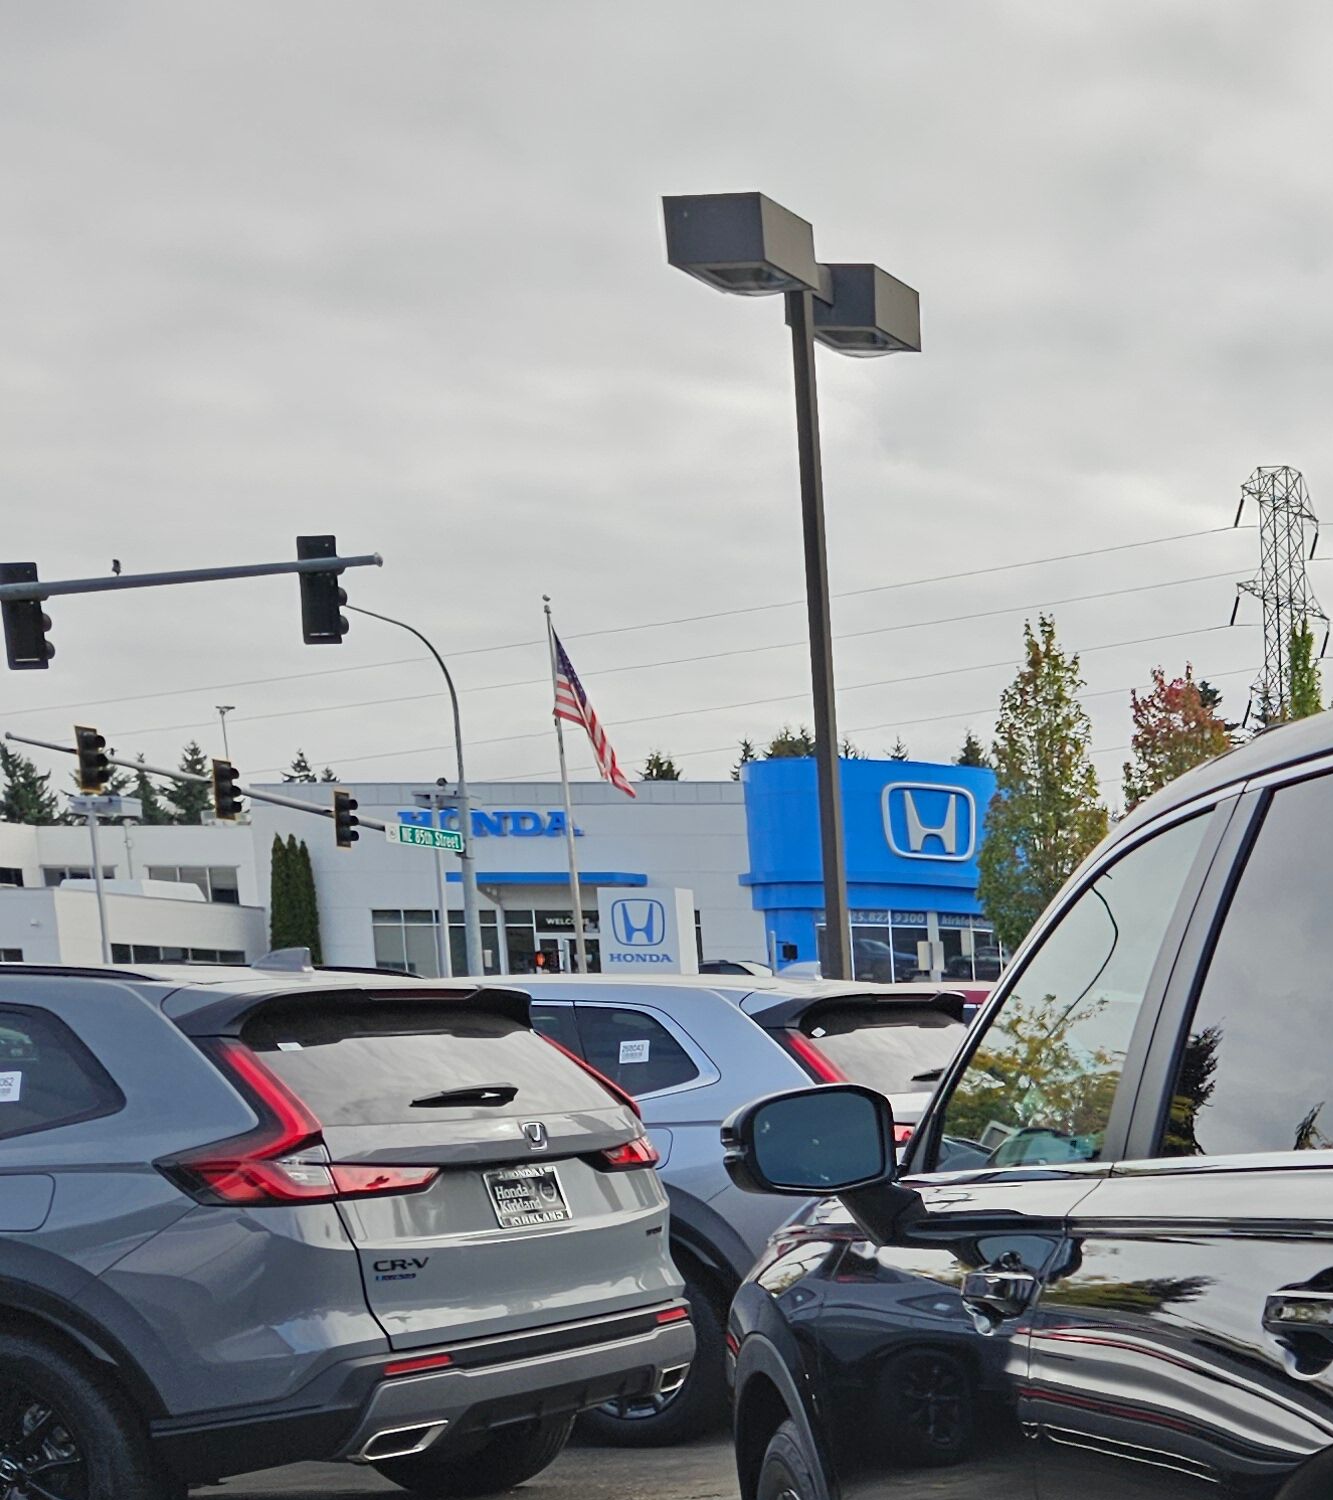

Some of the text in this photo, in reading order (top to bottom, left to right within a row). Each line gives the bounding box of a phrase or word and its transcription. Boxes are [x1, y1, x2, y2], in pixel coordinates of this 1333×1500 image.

[402, 827, 460, 849] NE 85th Street
[609, 953, 673, 963] HONDA
[494, 1184, 529, 1199] Honda
[498, 1197, 543, 1214] Kirkland
[373, 1257, 429, 1272] CR-V
